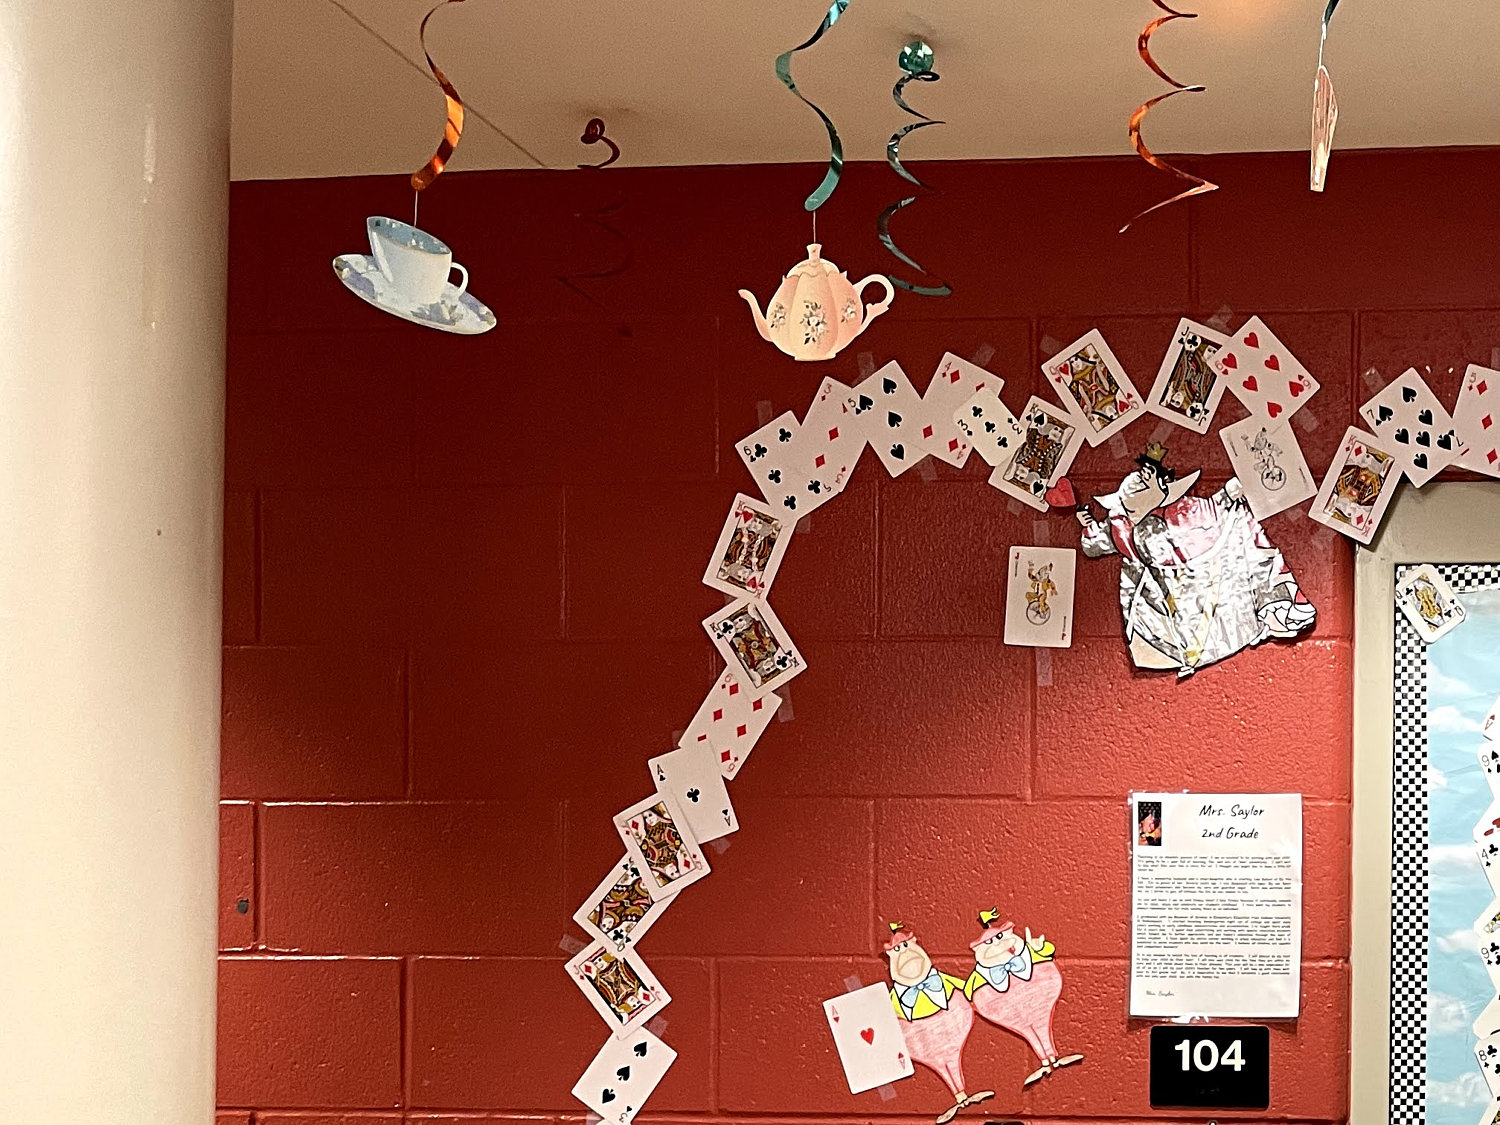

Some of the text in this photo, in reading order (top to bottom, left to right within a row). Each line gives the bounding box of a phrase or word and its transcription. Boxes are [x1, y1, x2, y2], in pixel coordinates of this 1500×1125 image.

[1199, 804, 1265, 819] Mrs. Saylor
[1202, 827, 1259, 839] 2nd Grade
[1175, 1039, 1246, 1072] 104
